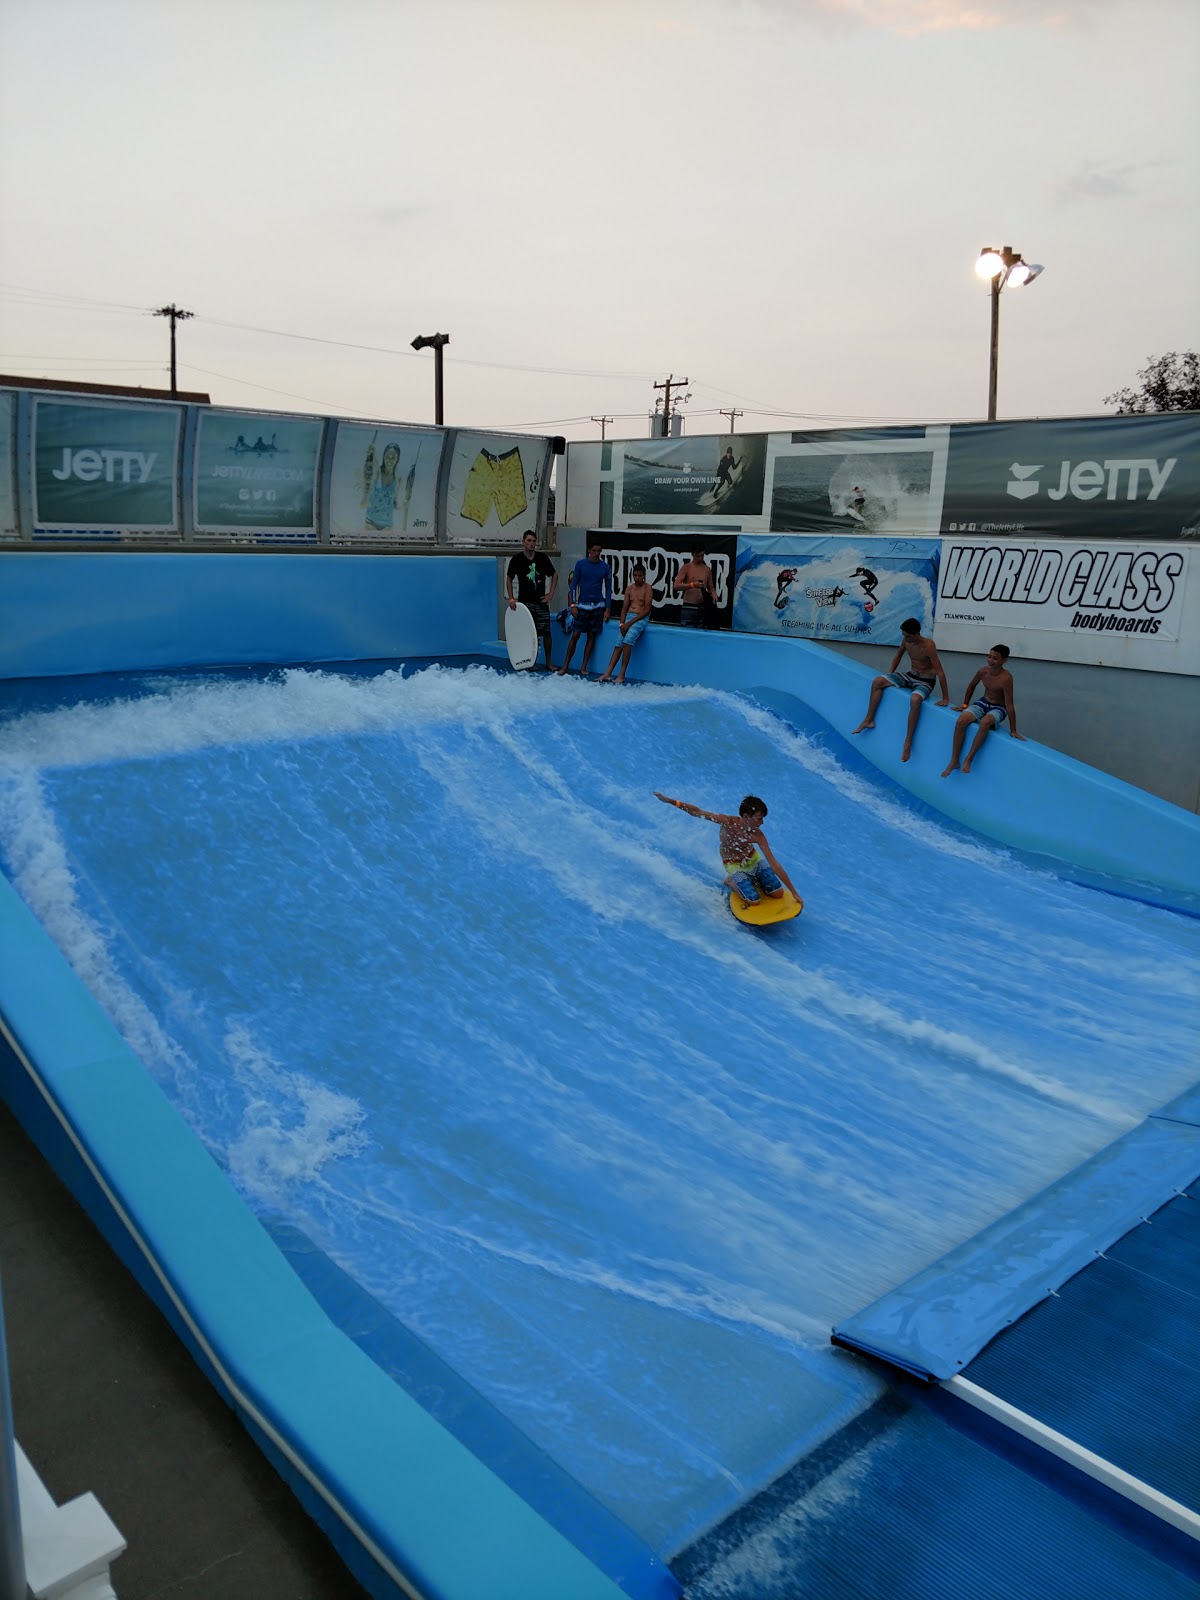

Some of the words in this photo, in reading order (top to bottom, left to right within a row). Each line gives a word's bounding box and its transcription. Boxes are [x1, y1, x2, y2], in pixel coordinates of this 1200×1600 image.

[654, 477, 672, 485] DRAW
[690, 476, 706, 484] OWN
[706, 476, 722, 484] LINE
[940, 546, 1063, 605] WORLD
[1057, 550, 1184, 613] CLASS
[944, 613, 985, 622] TEAMWCB.COM
[1071, 611, 1162, 634] bodyboards
[781, 619, 814, 631] STREAMING
[816, 622, 830, 631] LIVE
[831, 623, 842, 632] ALL
[844, 625, 872, 635] SUMMER
